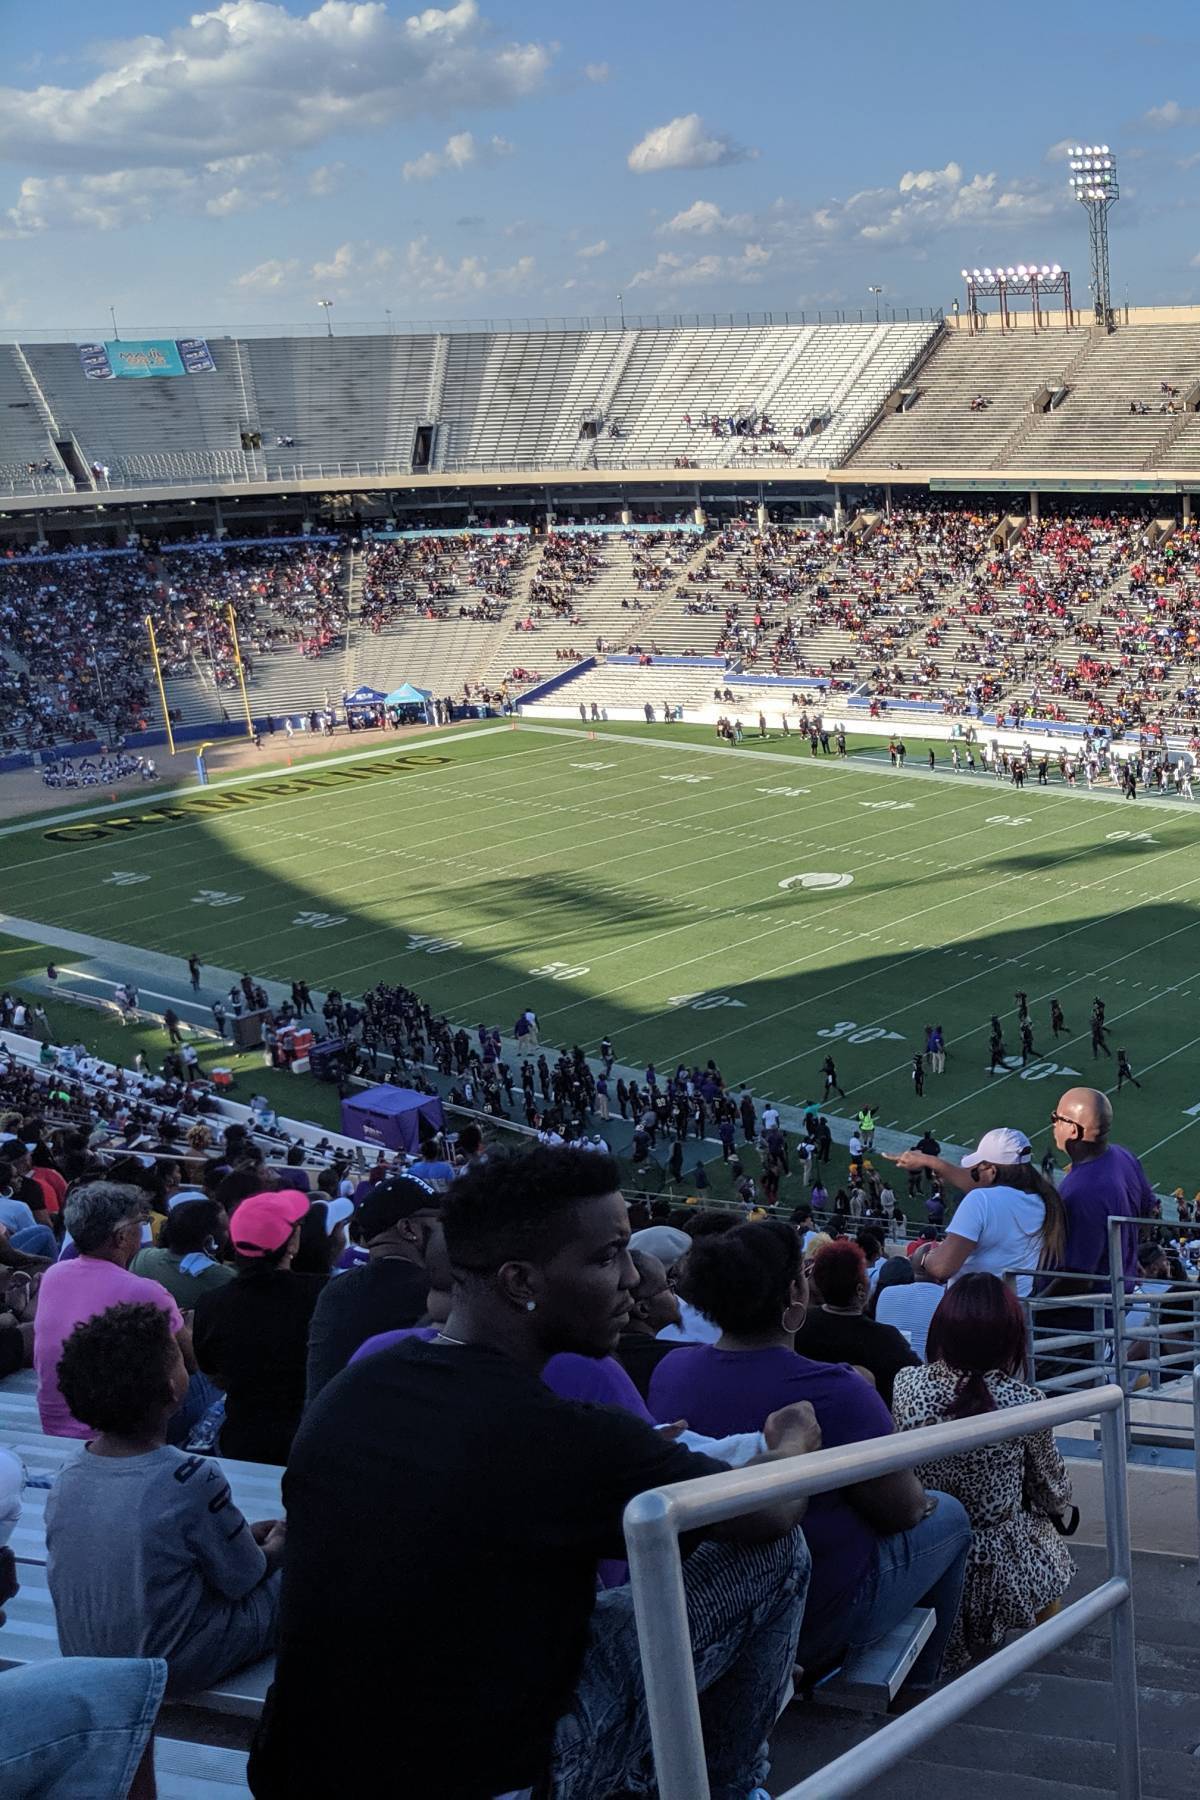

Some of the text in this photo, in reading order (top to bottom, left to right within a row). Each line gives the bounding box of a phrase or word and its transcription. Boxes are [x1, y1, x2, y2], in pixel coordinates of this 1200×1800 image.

[42, 754, 457, 843] GRAMBLING
[984, 814, 1033, 827] 50
[291, 911, 348, 929] 30
[404, 935, 463, 954] 40
[528, 961, 590, 981] 50
[666, 991, 731, 1011] 40
[816, 1021, 887, 1044] 30
